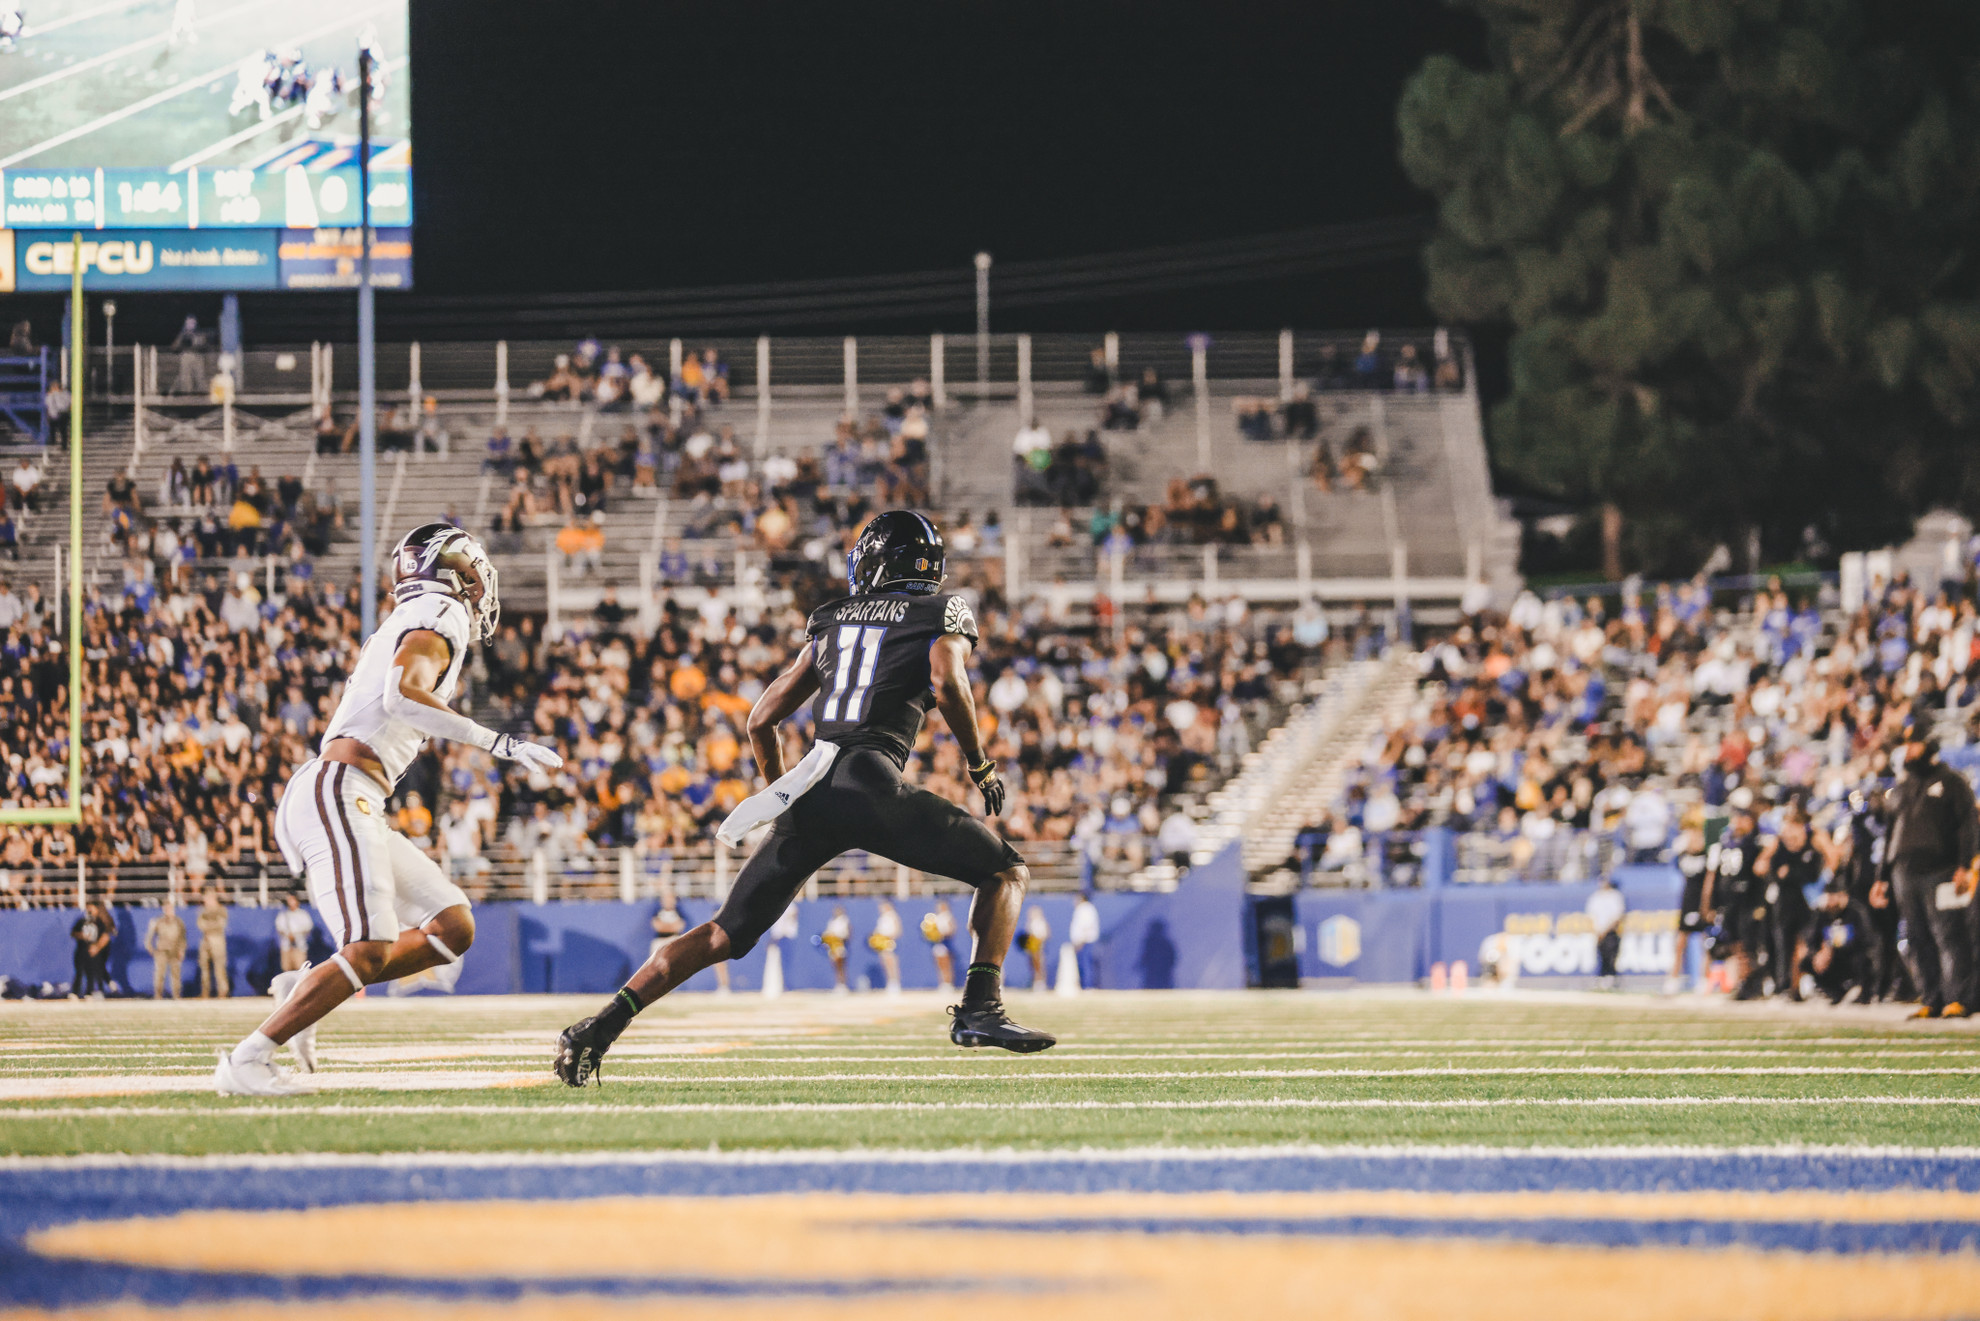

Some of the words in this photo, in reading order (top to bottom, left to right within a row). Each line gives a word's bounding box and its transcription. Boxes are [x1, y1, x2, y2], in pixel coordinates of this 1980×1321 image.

[25, 241, 153, 275] CEFCU
[436, 600, 452, 619] 7
[835, 600, 910, 623] SPARTANS
[822, 625, 888, 722] 11
[1506, 933, 1676, 974] FOOTALL
